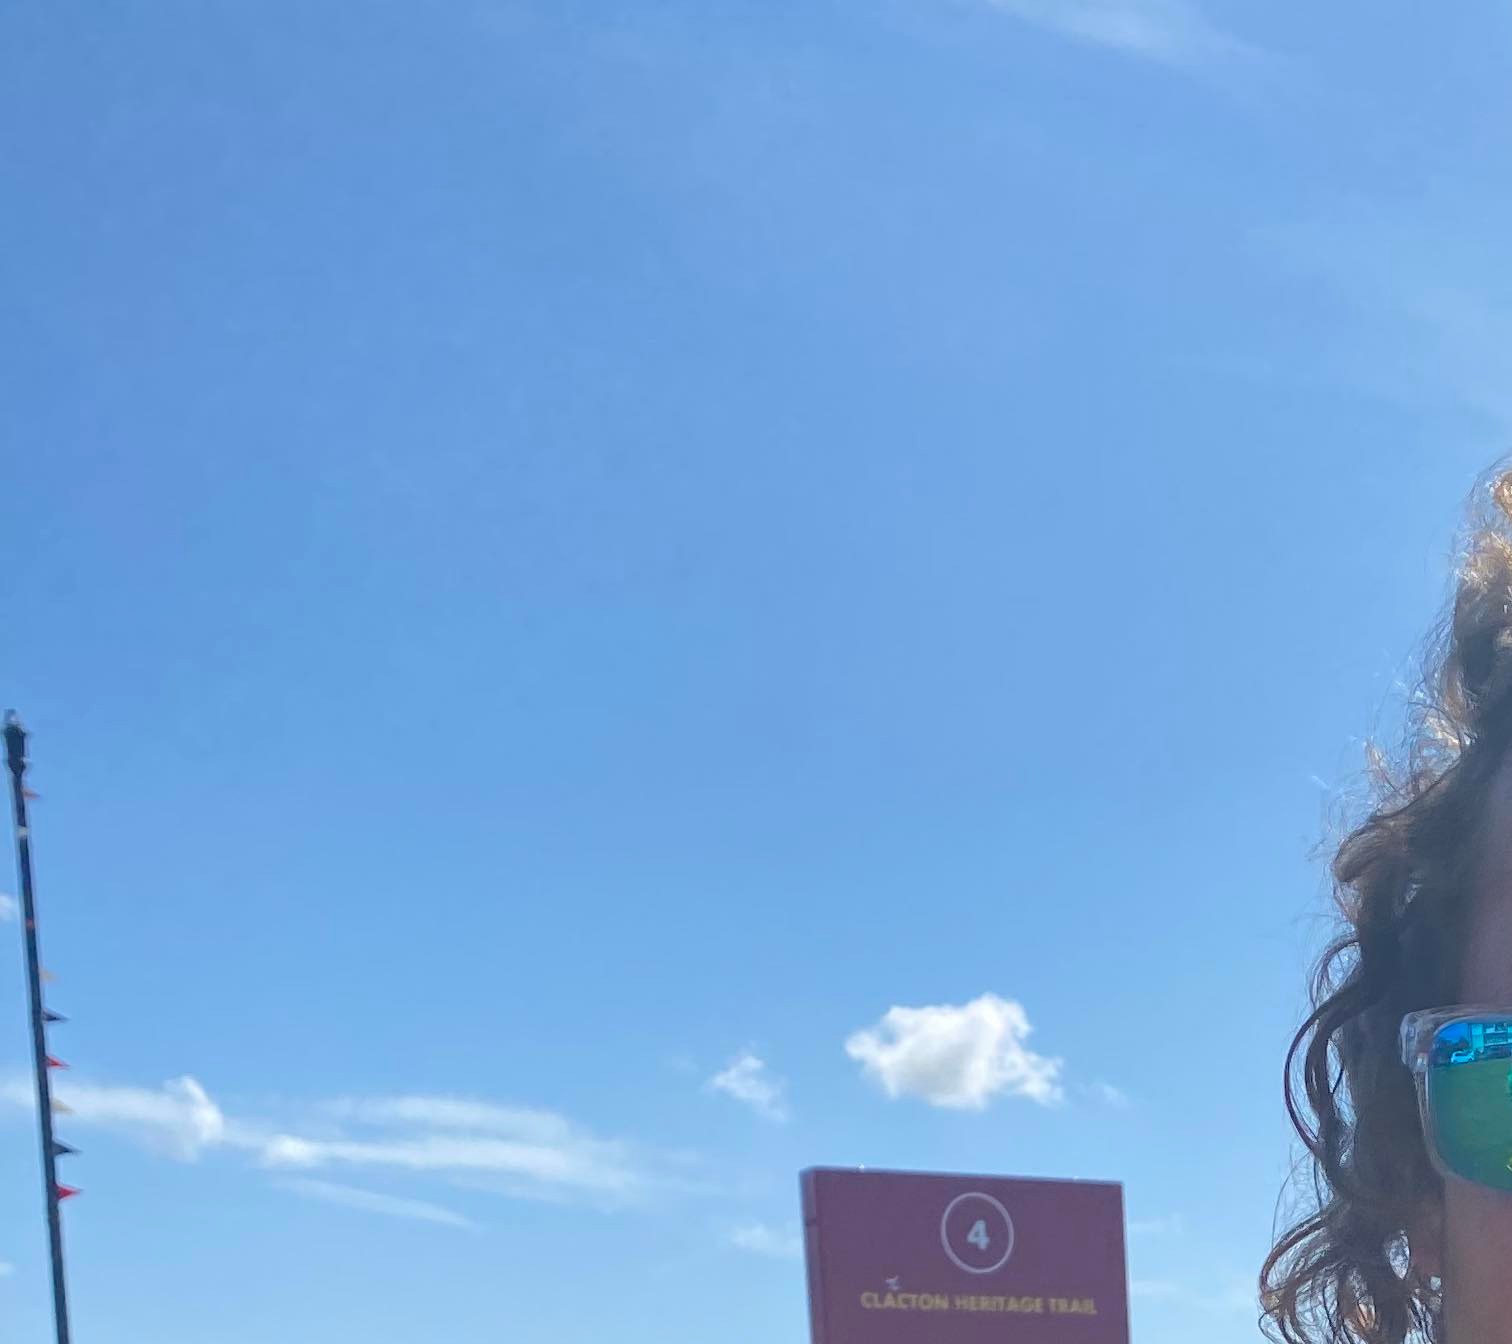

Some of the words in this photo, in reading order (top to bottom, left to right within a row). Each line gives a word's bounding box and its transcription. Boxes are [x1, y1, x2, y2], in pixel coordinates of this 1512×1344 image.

[966, 1219, 990, 1250] 4
[860, 1291, 949, 1312] CLACTON
[954, 1294, 1043, 1314] HERITAGE
[1049, 1297, 1097, 1315] TRAIL
